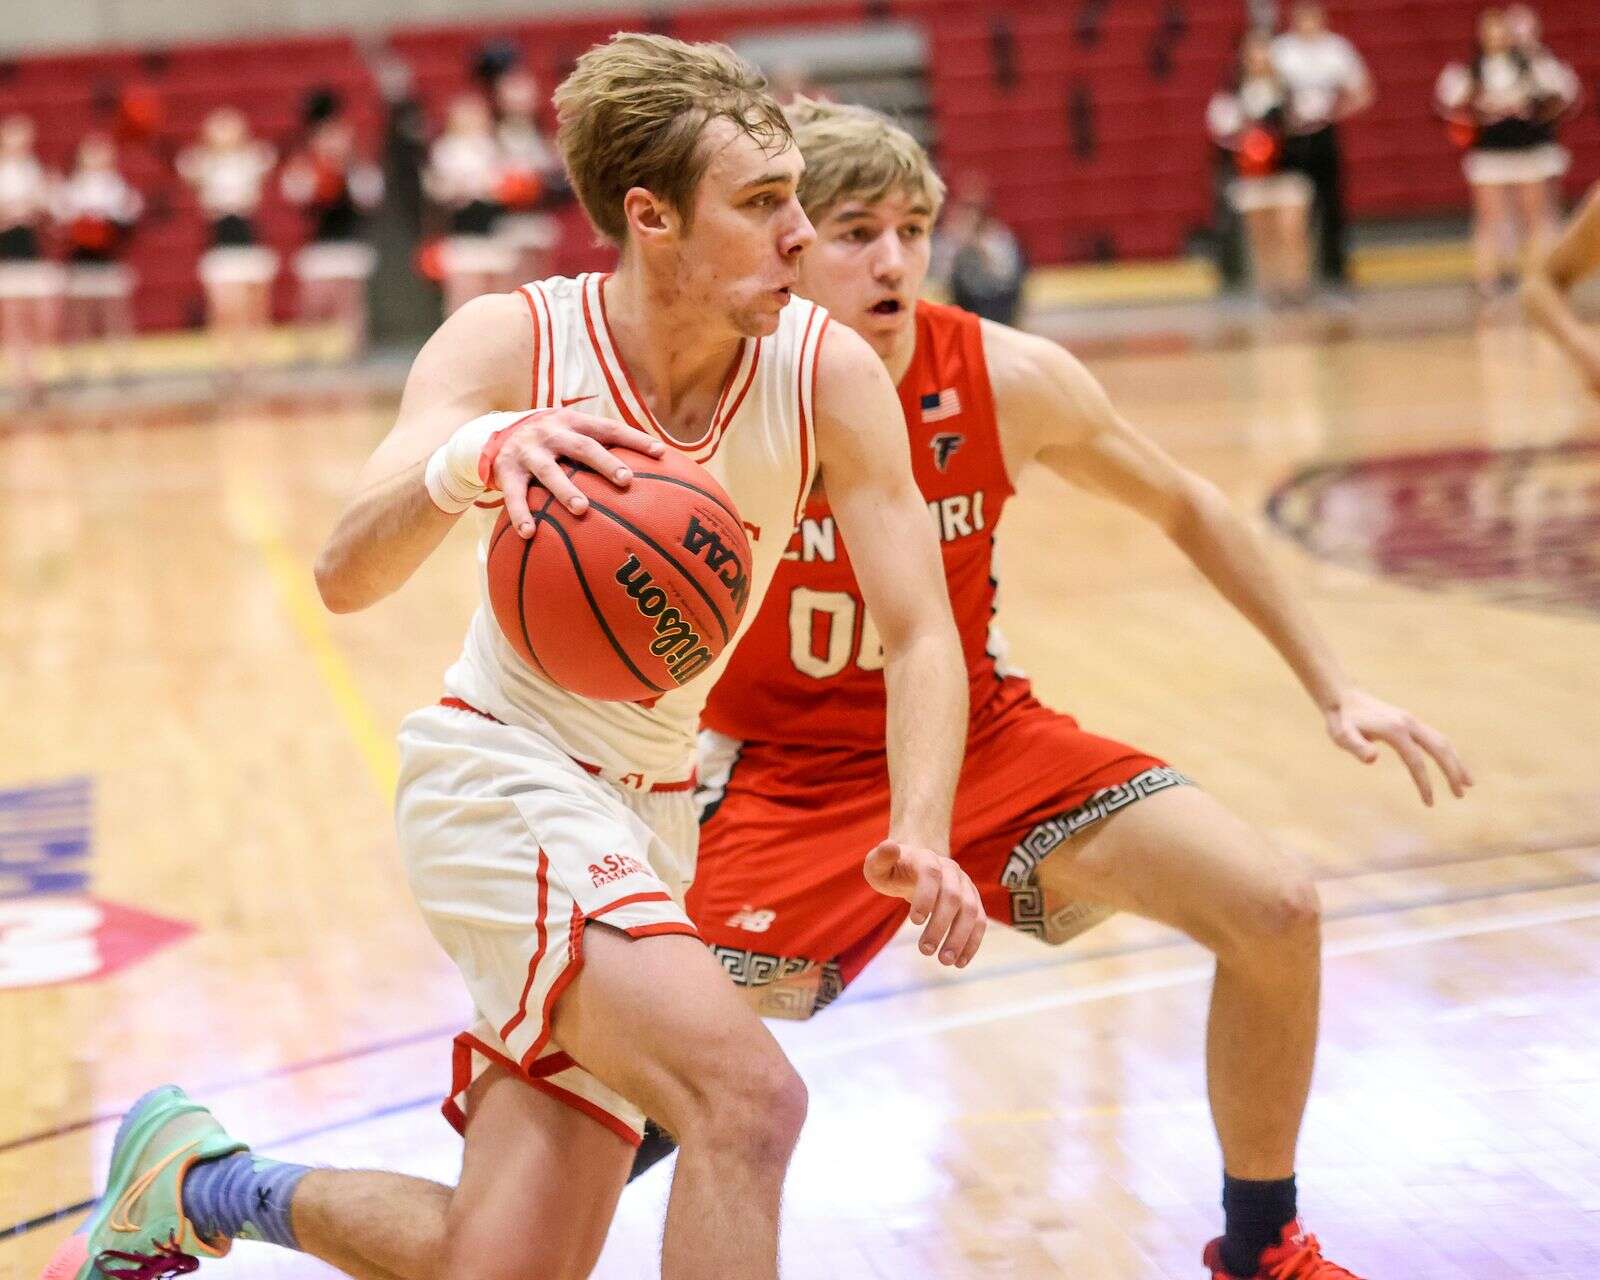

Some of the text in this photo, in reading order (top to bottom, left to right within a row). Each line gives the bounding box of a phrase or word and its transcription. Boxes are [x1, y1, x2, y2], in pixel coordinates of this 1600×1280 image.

[682, 515, 748, 615] NCAA
[783, 516, 837, 562] N
[615, 553, 713, 686] Wilson
